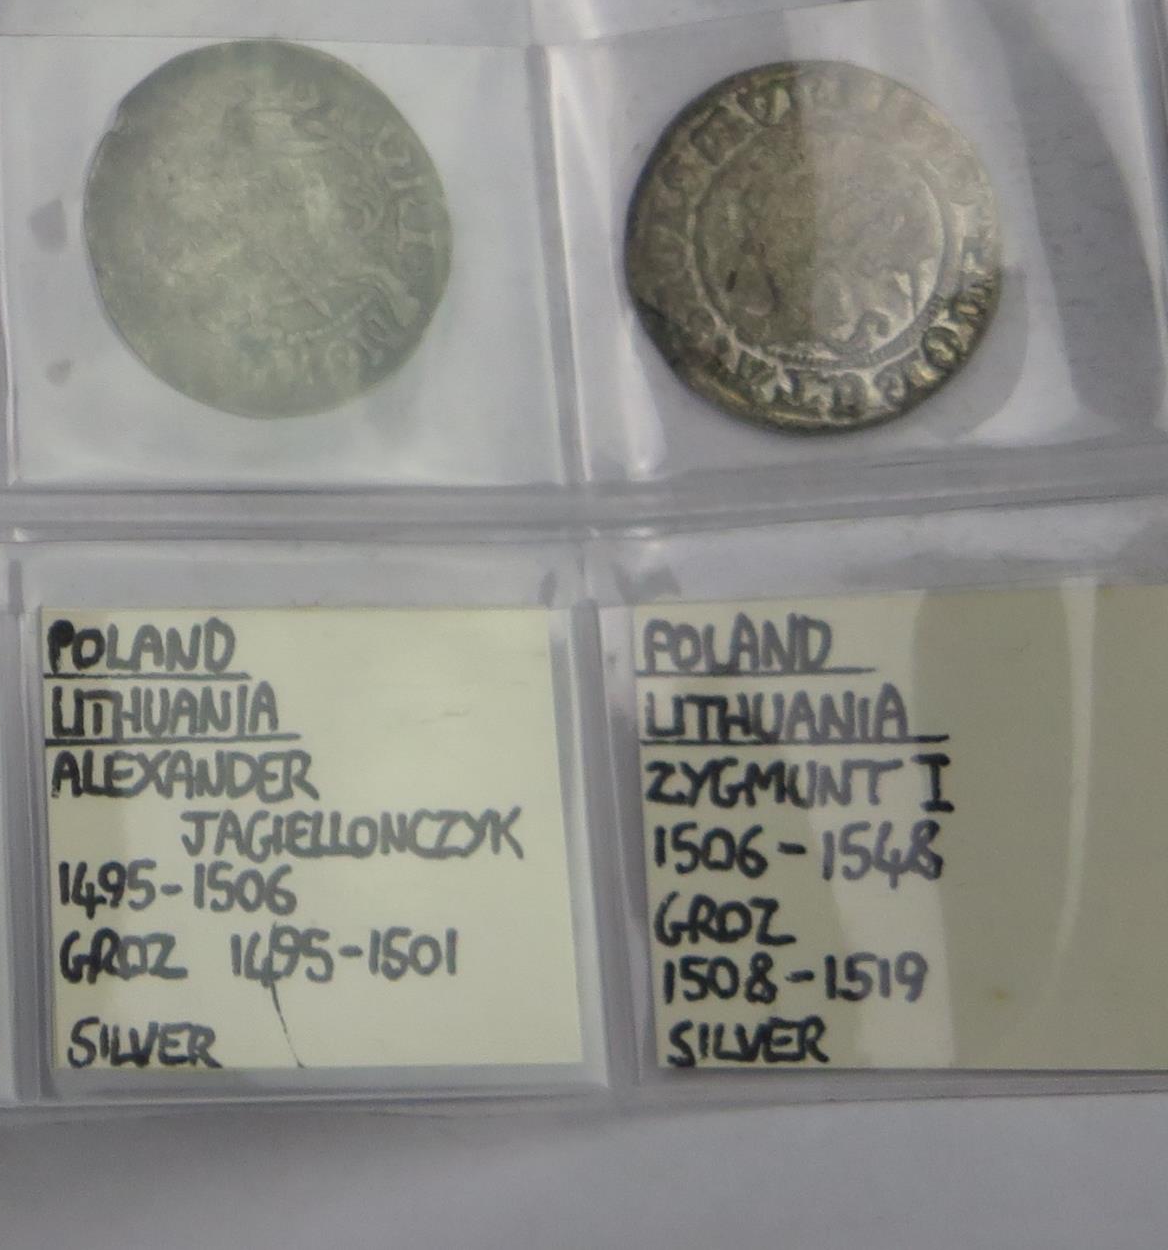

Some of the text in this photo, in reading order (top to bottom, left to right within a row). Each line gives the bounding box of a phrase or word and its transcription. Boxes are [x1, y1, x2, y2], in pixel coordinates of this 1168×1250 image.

[47, 617, 235, 672] POLAND
[644, 613, 832, 674] POLAND
[51, 680, 279, 739] LITHUANIA
[646, 682, 908, 741] LITHUANIA
[51, 749, 319, 803] ALEXANDER
[645, 752, 955, 813] ZYGMUNT I
[180, 807, 524, 862] JAGIELLONCZYK
[653, 890, 797, 947] GROZ
[59, 927, 188, 984] GROZ
[67, 1017, 222, 1068] SILVER
[667, 1015, 830, 1067] SILVER
